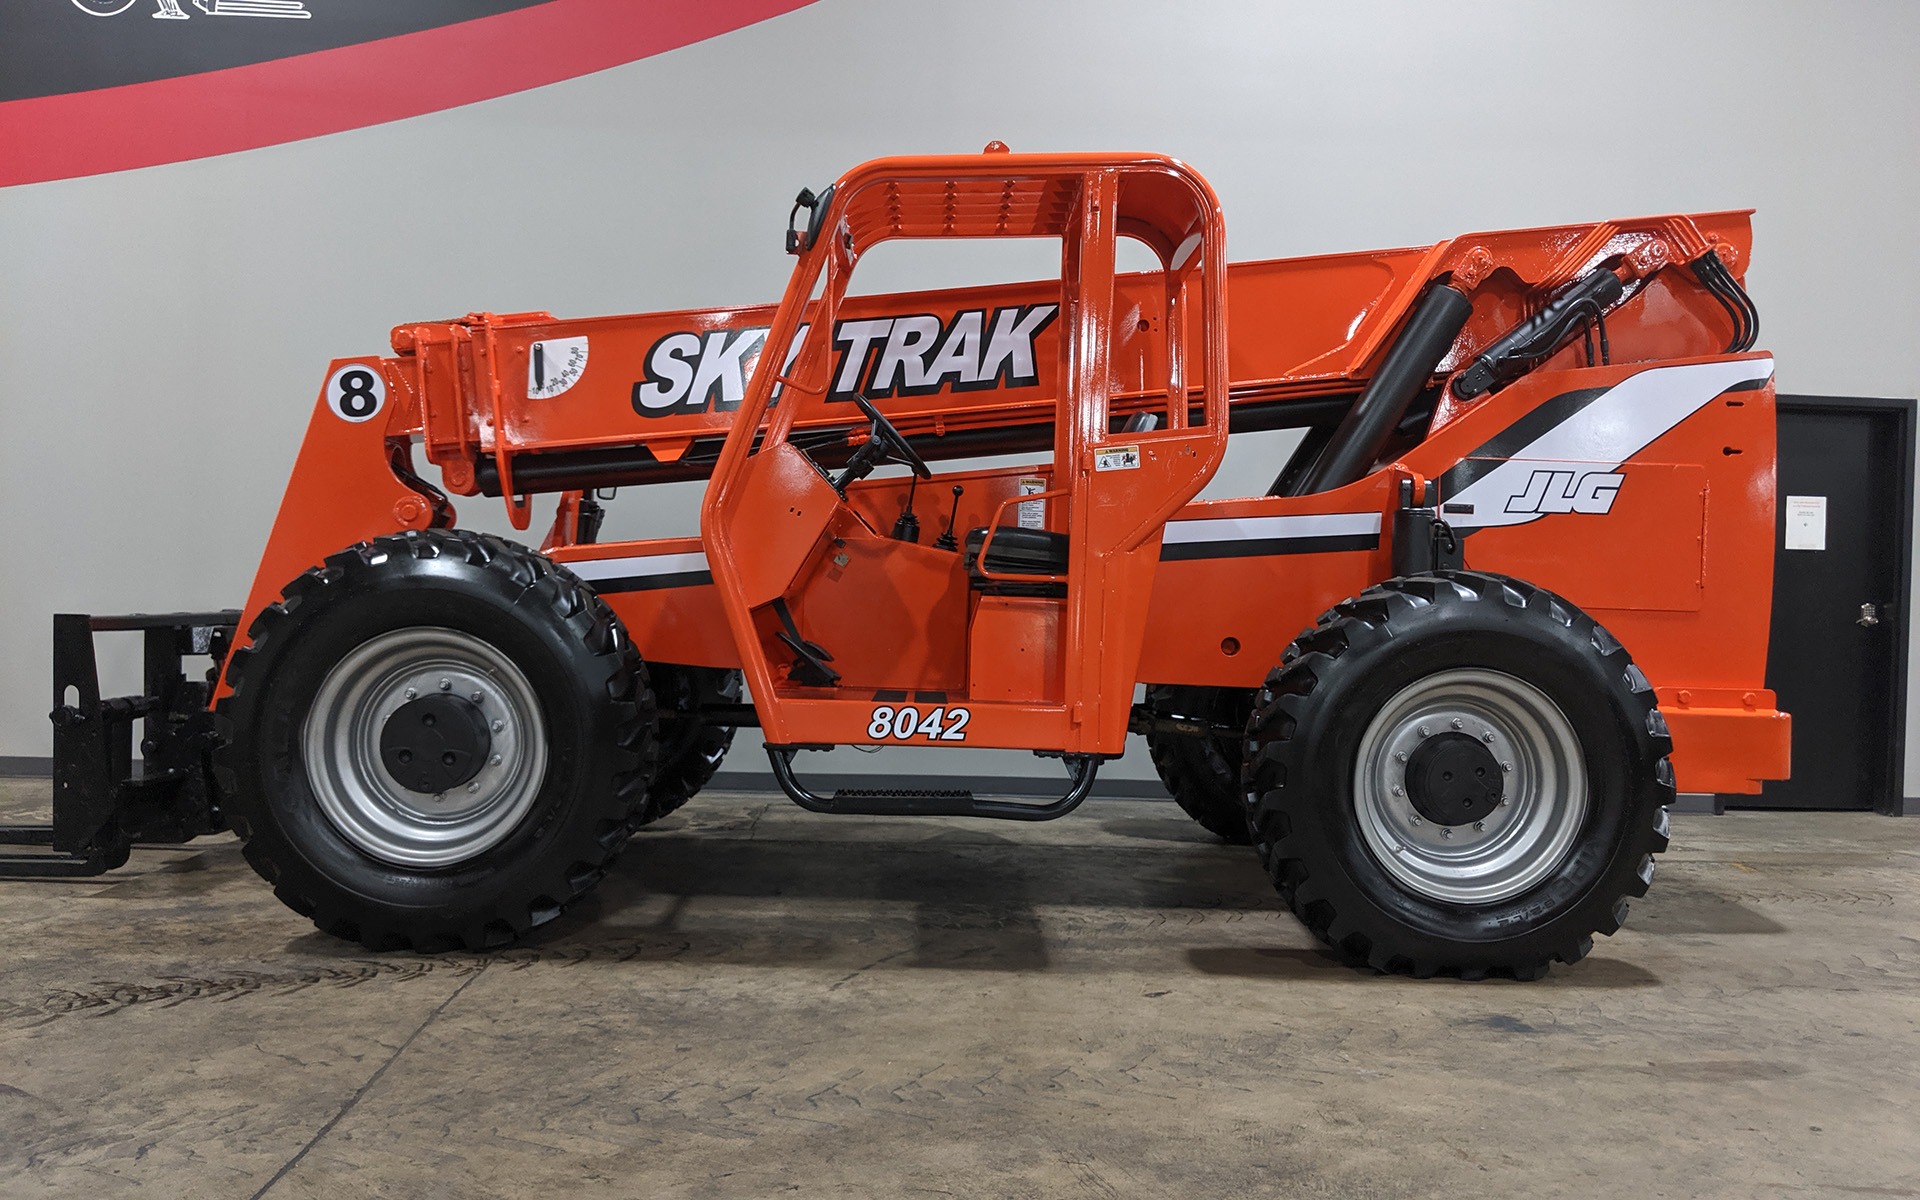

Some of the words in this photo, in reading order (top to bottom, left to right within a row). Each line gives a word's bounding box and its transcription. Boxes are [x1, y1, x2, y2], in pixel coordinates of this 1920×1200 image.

[833, 304, 1059, 396] TRAK
[339, 370, 377, 417] 8
[1503, 470, 1627, 515] JLG
[866, 705, 971, 742] 8042
